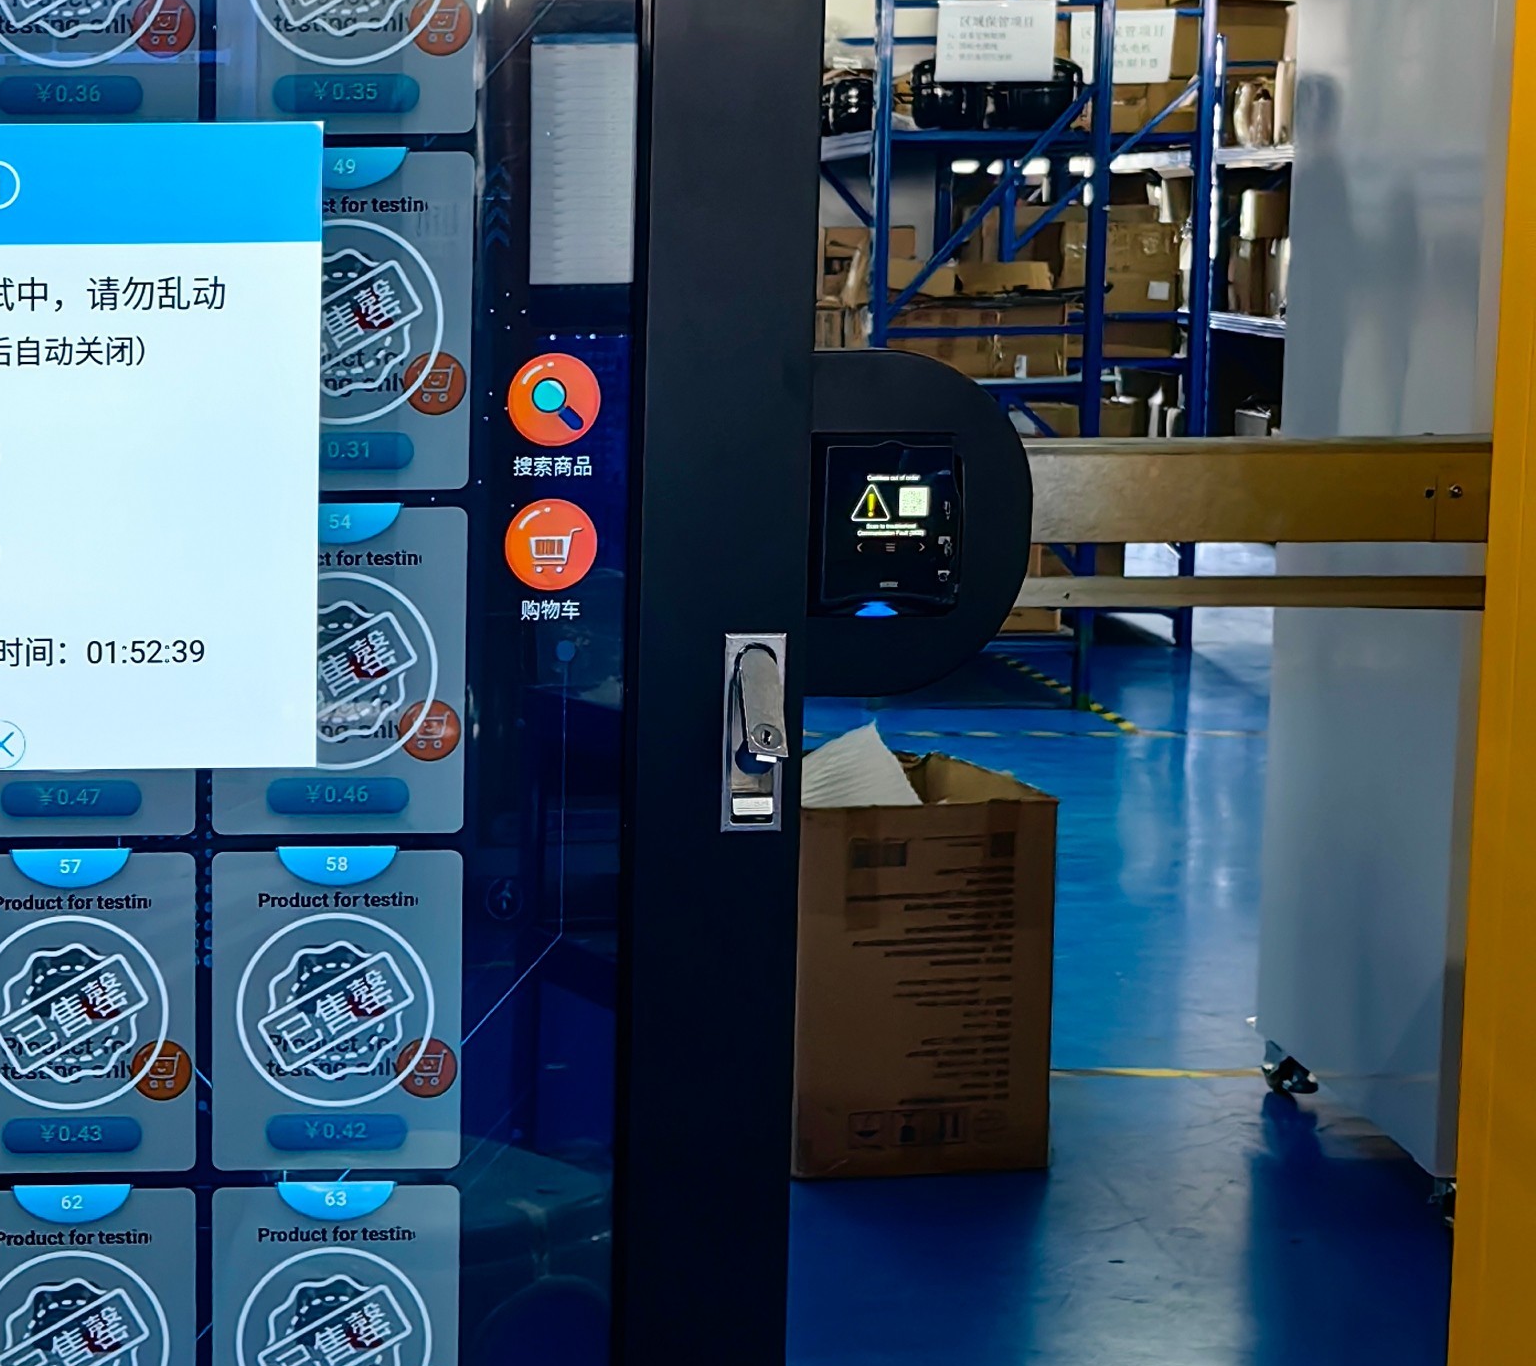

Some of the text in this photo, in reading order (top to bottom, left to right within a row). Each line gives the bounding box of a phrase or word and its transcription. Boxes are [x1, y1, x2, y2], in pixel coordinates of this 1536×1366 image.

[36, 83, 101, 103] ¥0.36
[313, 81, 378, 100] ¥0.35
[333, 159, 356, 174] 49
[341, 196, 368, 213] for
[371, 196, 428, 213] testin
[323, 280, 402, 345] 售罄
[513, 456, 592, 477] 搜索商品
[329, 515, 351, 529] 54
[336, 550, 363, 566] for
[366, 550, 422, 566] testin
[521, 600, 581, 621] 购物车
[319, 630, 398, 696] 售罄
[36, 787, 101, 805] ¥0.47
[305, 784, 369, 803] ¥0.46
[59, 859, 80, 874] 57
[326, 857, 347, 872] 58
[67, 894, 93, 910] for
[97, 894, 151, 909] testin
[258, 891, 418, 908] Product for testin
[11, 972, 128, 1057] 已售罄
[276, 970, 393, 1053] 已售罄
[40, 1124, 102, 1142] ¥0.43
[304, 1121, 367, 1139] ¥0.42
[61, 1195, 83, 1210] 62
[325, 1192, 346, 1207] 63
[68, 1229, 95, 1245] for
[98, 1229, 151, 1245] testin
[258, 1226, 416, 1243] Product for testin
